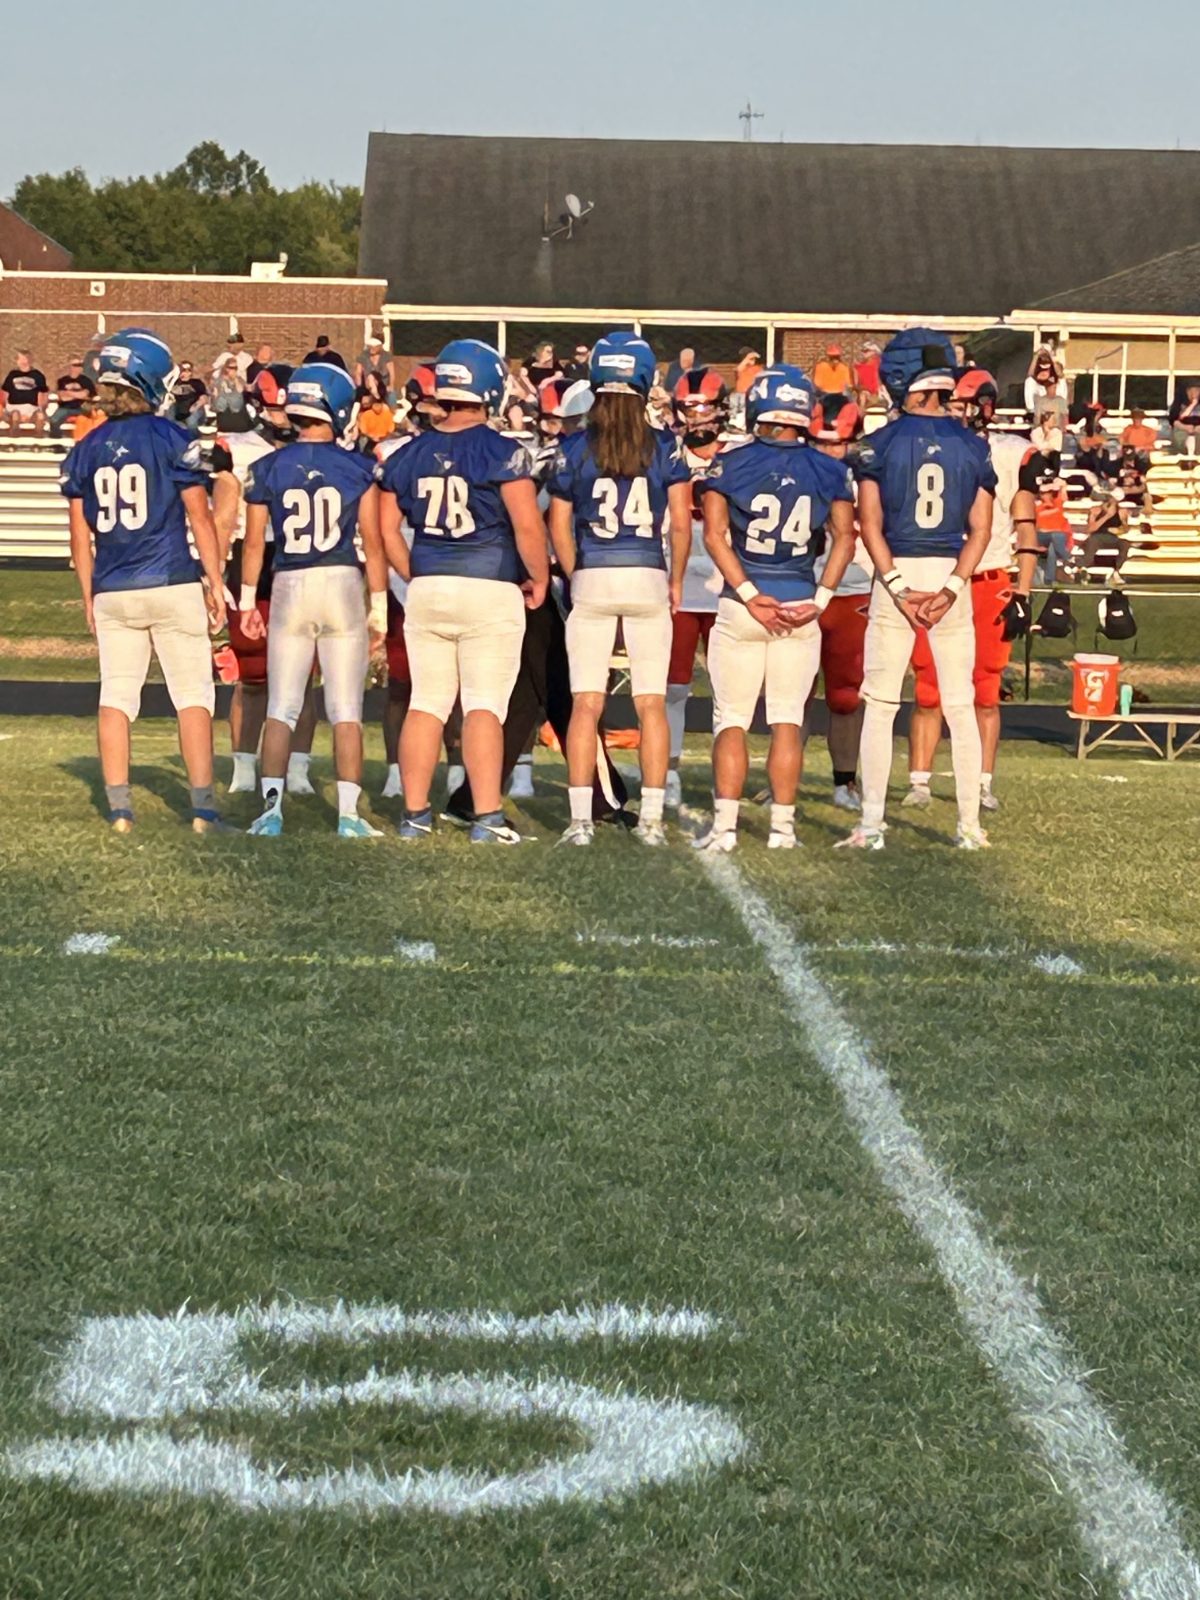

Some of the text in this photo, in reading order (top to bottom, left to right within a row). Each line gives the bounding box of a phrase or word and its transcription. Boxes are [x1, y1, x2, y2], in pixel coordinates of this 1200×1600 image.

[93, 463, 148, 533] 99
[282, 486, 342, 555] 20
[417, 475, 476, 539] 78
[589, 476, 654, 539] 34
[745, 493, 812, 557] 24
[914, 463, 945, 529] 8
